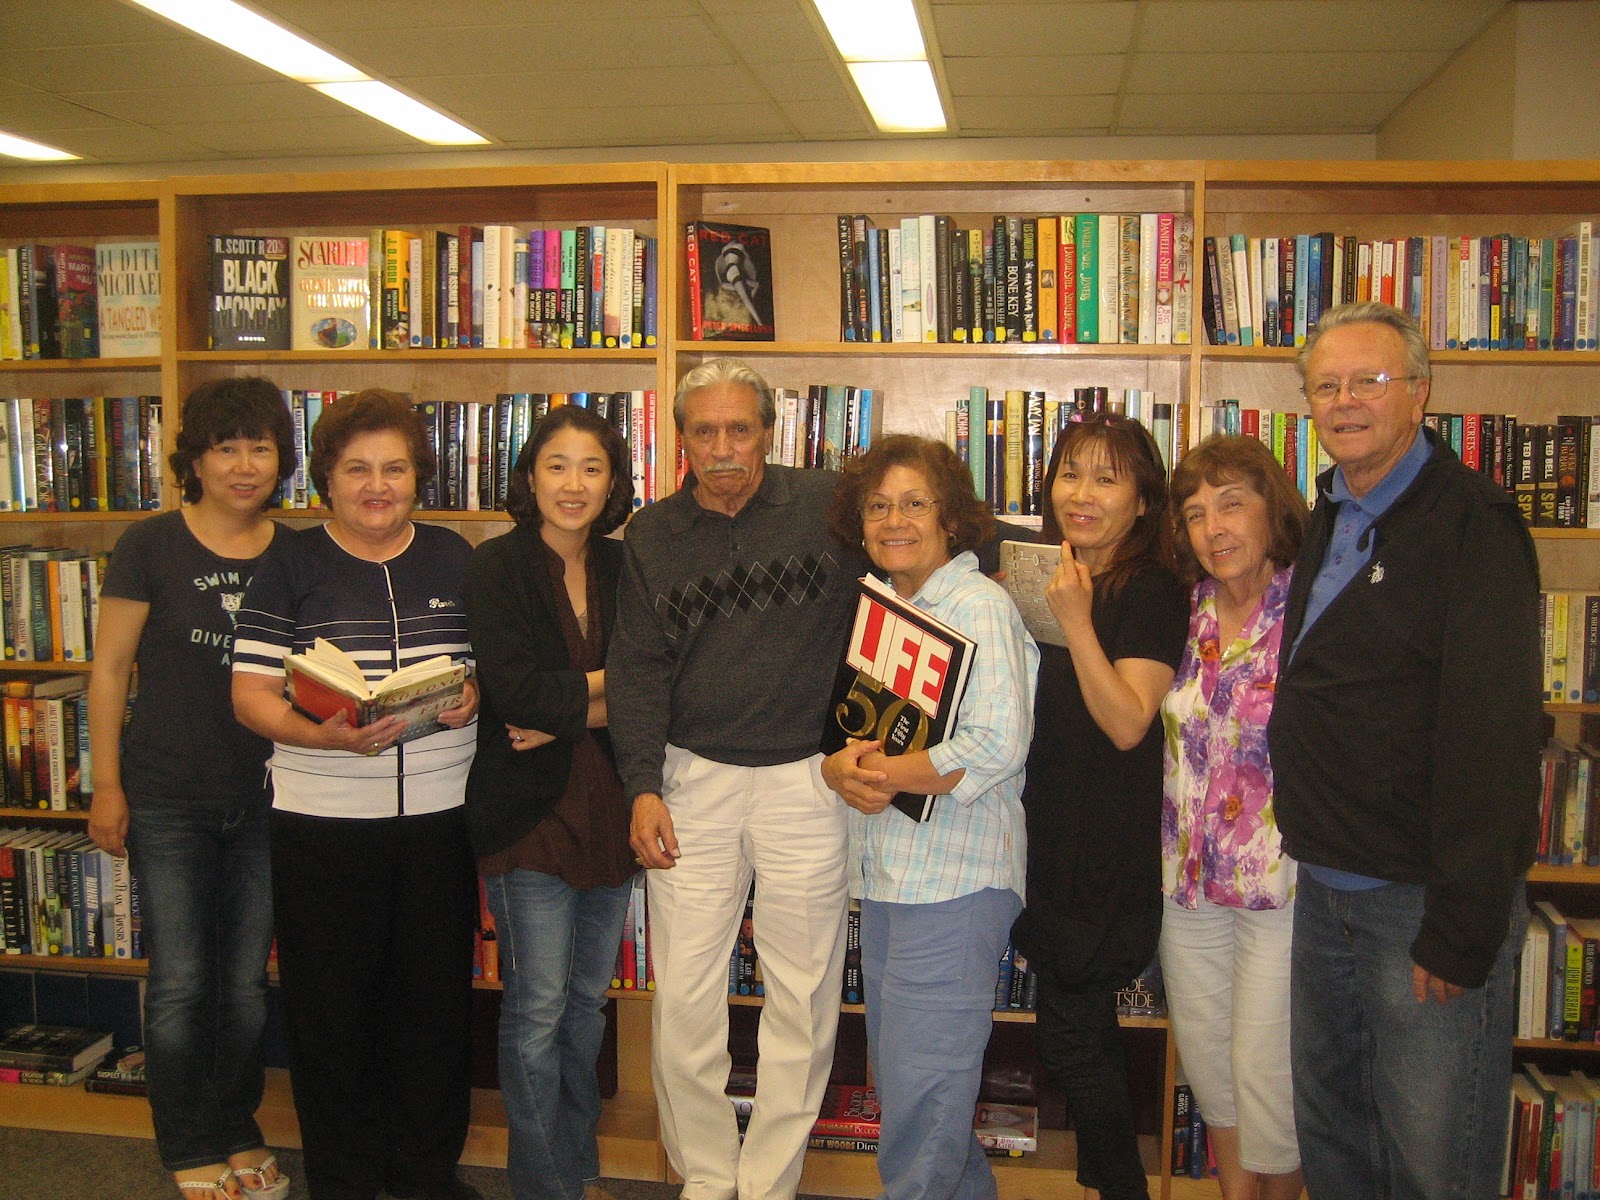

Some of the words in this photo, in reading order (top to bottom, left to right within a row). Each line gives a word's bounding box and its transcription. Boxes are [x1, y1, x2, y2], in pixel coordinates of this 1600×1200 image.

[1009, 219, 1018, 230] Les
[227, 239, 256, 254] SCOTT
[577, 232, 586, 246] IAN
[686, 226, 695, 252] RED
[840, 219, 848, 258] SPRING
[1160, 218, 1172, 255] DANIELLE
[224, 260, 279, 294] BLACK
[577, 250, 586, 282] RANKIN
[688, 258, 697, 282] CAT
[1160, 257, 1172, 280] STEEL
[448, 275, 458, 306] ASSAULT
[1008, 266, 1018, 294] BONE
[1024, 272, 1033, 310] HAVANA
[576, 290, 586, 312] QUESTION
[996, 286, 1005, 306] DEEPER
[1008, 296, 1018, 317] KEY
[622, 304, 630, 334] DESTINY
[996, 308, 1005, 323] SLEEP
[1028, 394, 1043, 417] AMY
[1028, 417, 1043, 436] TAN
[1466, 416, 1476, 450] SECRETS
[1522, 441, 1532, 457] TED
[1546, 440, 1554, 456] TED
[1560, 446, 1568, 472] BERRY
[1522, 460, 1532, 480] BELL
[1546, 458, 1554, 480] BELL
[1518, 494, 1532, 520] SPY
[1540, 492, 1555, 518] SPY
[194, 572, 240, 590] SWIM
[191, 628, 232, 648] DIVE
[848, 594, 952, 718] LIFE
[413, 676, 460, 696] LONG
[836, 666, 928, 756] 50
[900, 714, 910, 726] The
[894, 727, 908, 740] Fifty
[896, 721, 909, 734] First
[71, 854, 80, 872] JODI
[71, 875, 80, 909] PICOULT
[86, 876, 98, 909] RUNNER
[1568, 966, 1580, 984] JOHN
[1566, 986, 1580, 1018] GRISHAM
[827, 1140, 856, 1150] WOODS
